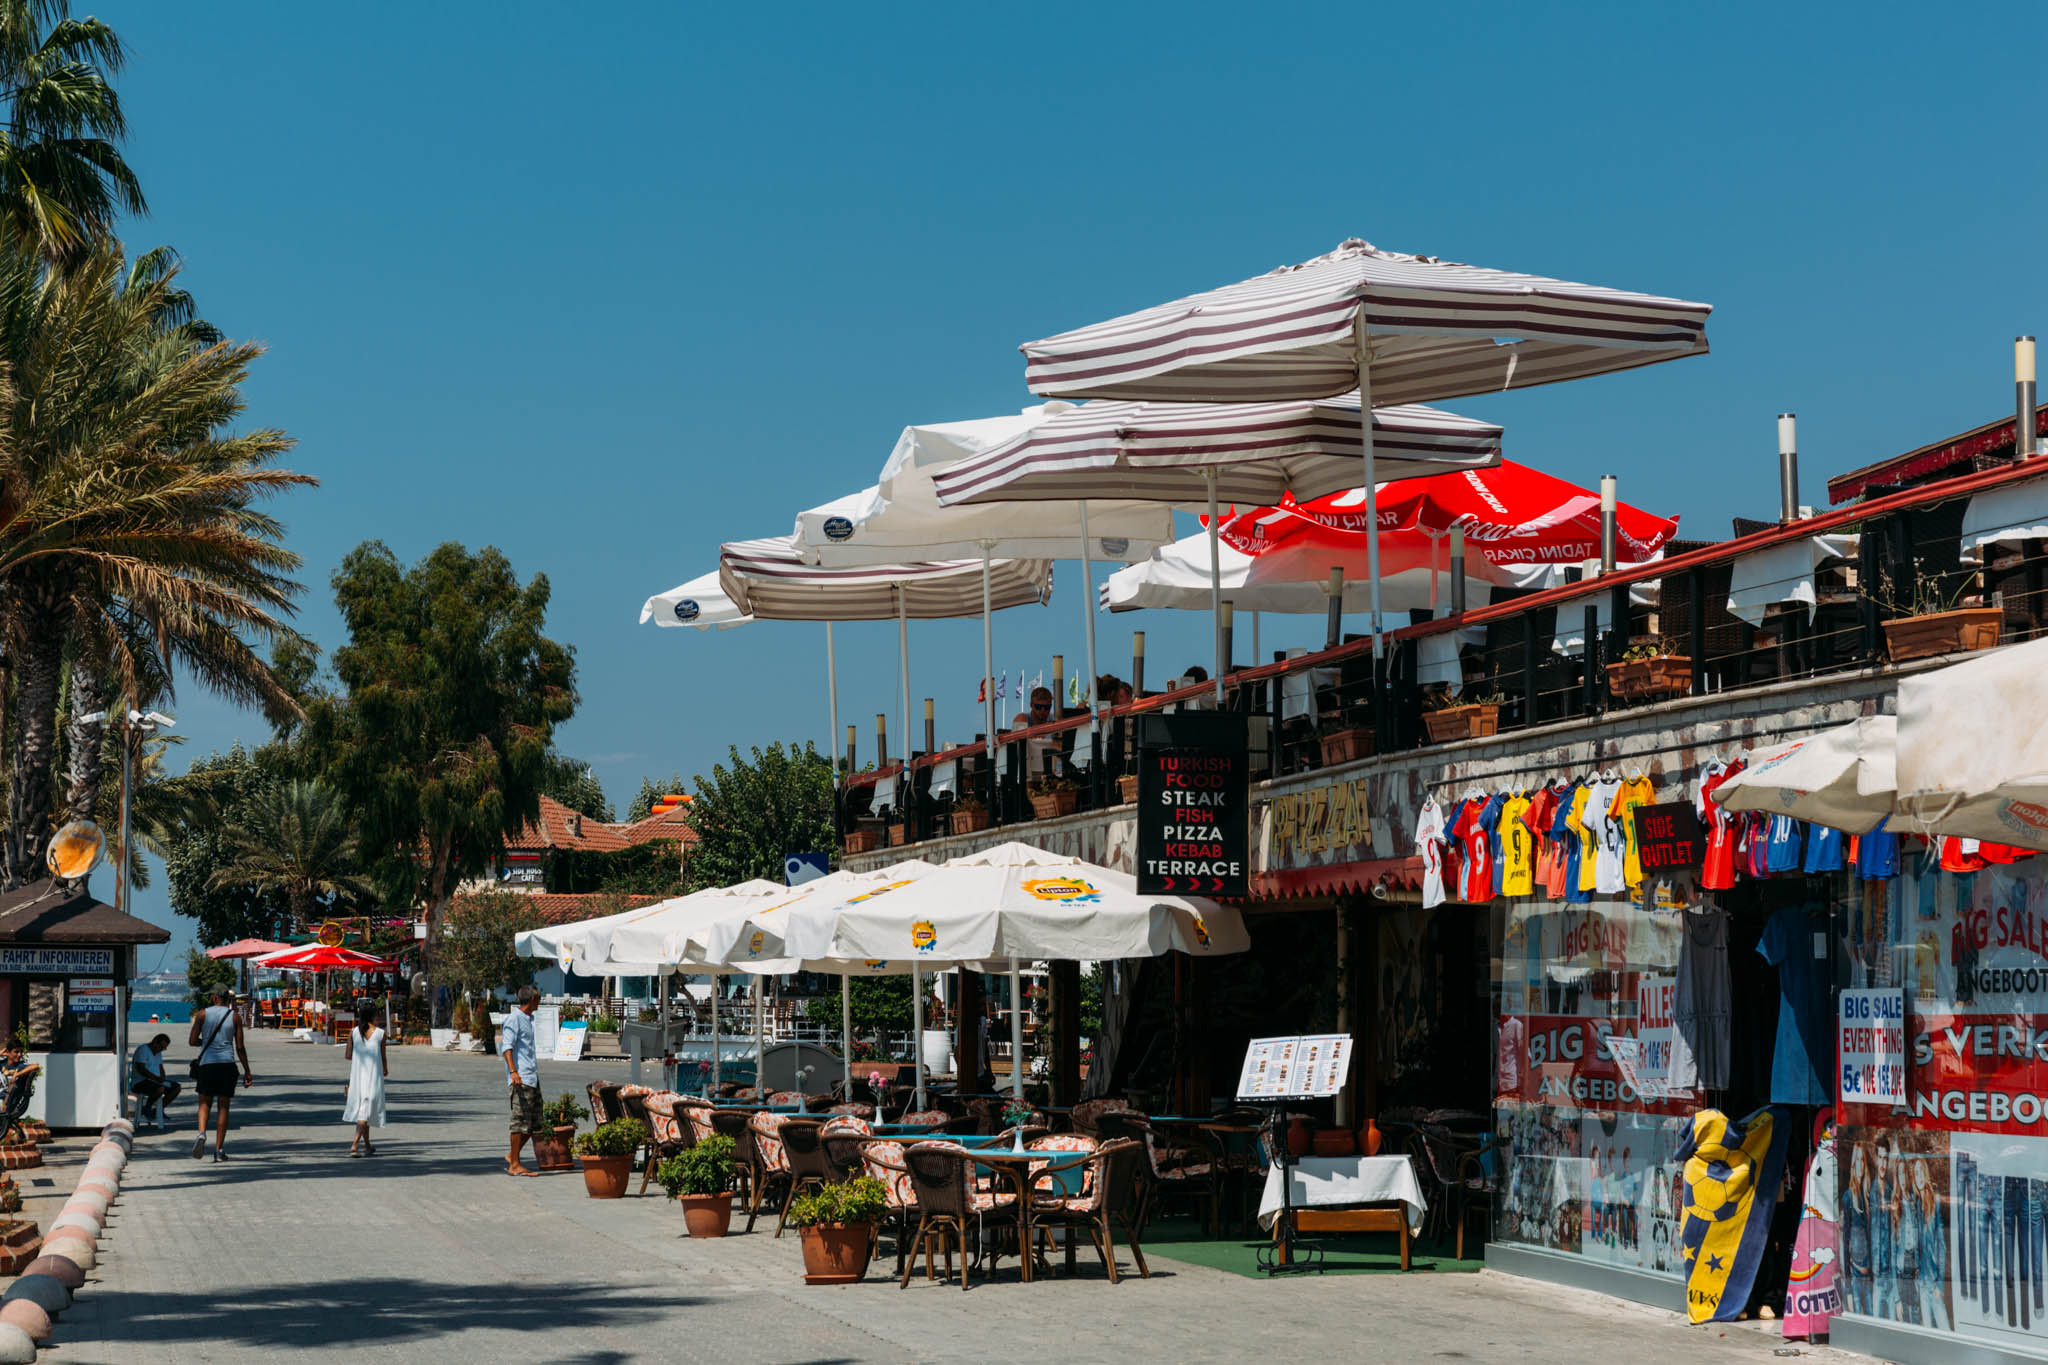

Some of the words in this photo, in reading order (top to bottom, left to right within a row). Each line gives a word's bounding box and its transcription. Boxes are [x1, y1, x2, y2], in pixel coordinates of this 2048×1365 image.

[1159, 757, 1231, 771] TURKISH
[1165, 773, 1224, 788] FOOD
[1161, 790, 1225, 806] STEAK
[1175, 808, 1214, 822] FISH
[1165, 843, 1223, 858] KEBAB
[1475, 835, 1485, 875] 9
[1512, 829, 1521, 865] 9
[1641, 841, 1693, 867] OUTLET
[1147, 860, 1240, 876] TERRACE
[1566, 923, 1589, 963] BIG
[1593, 920, 1627, 968] SALE
[1951, 907, 1988, 966] BIG
[3, 949, 36, 963] FAHRT
[39, 951, 111, 965] INFORMIEREN
[1844, 997, 1870, 1019] BIG
[1873, 996, 1902, 1019] SALE
[1530, 1024, 1584, 1070] BIG
[1944, 1024, 2048, 1063] VERK
[1843, 1064, 1861, 1093] 5€
[1862, 1064, 1876, 1095] 10€
[1877, 1064, 1890, 1096] 15€
[1890, 1064, 1902, 1096] 20€
